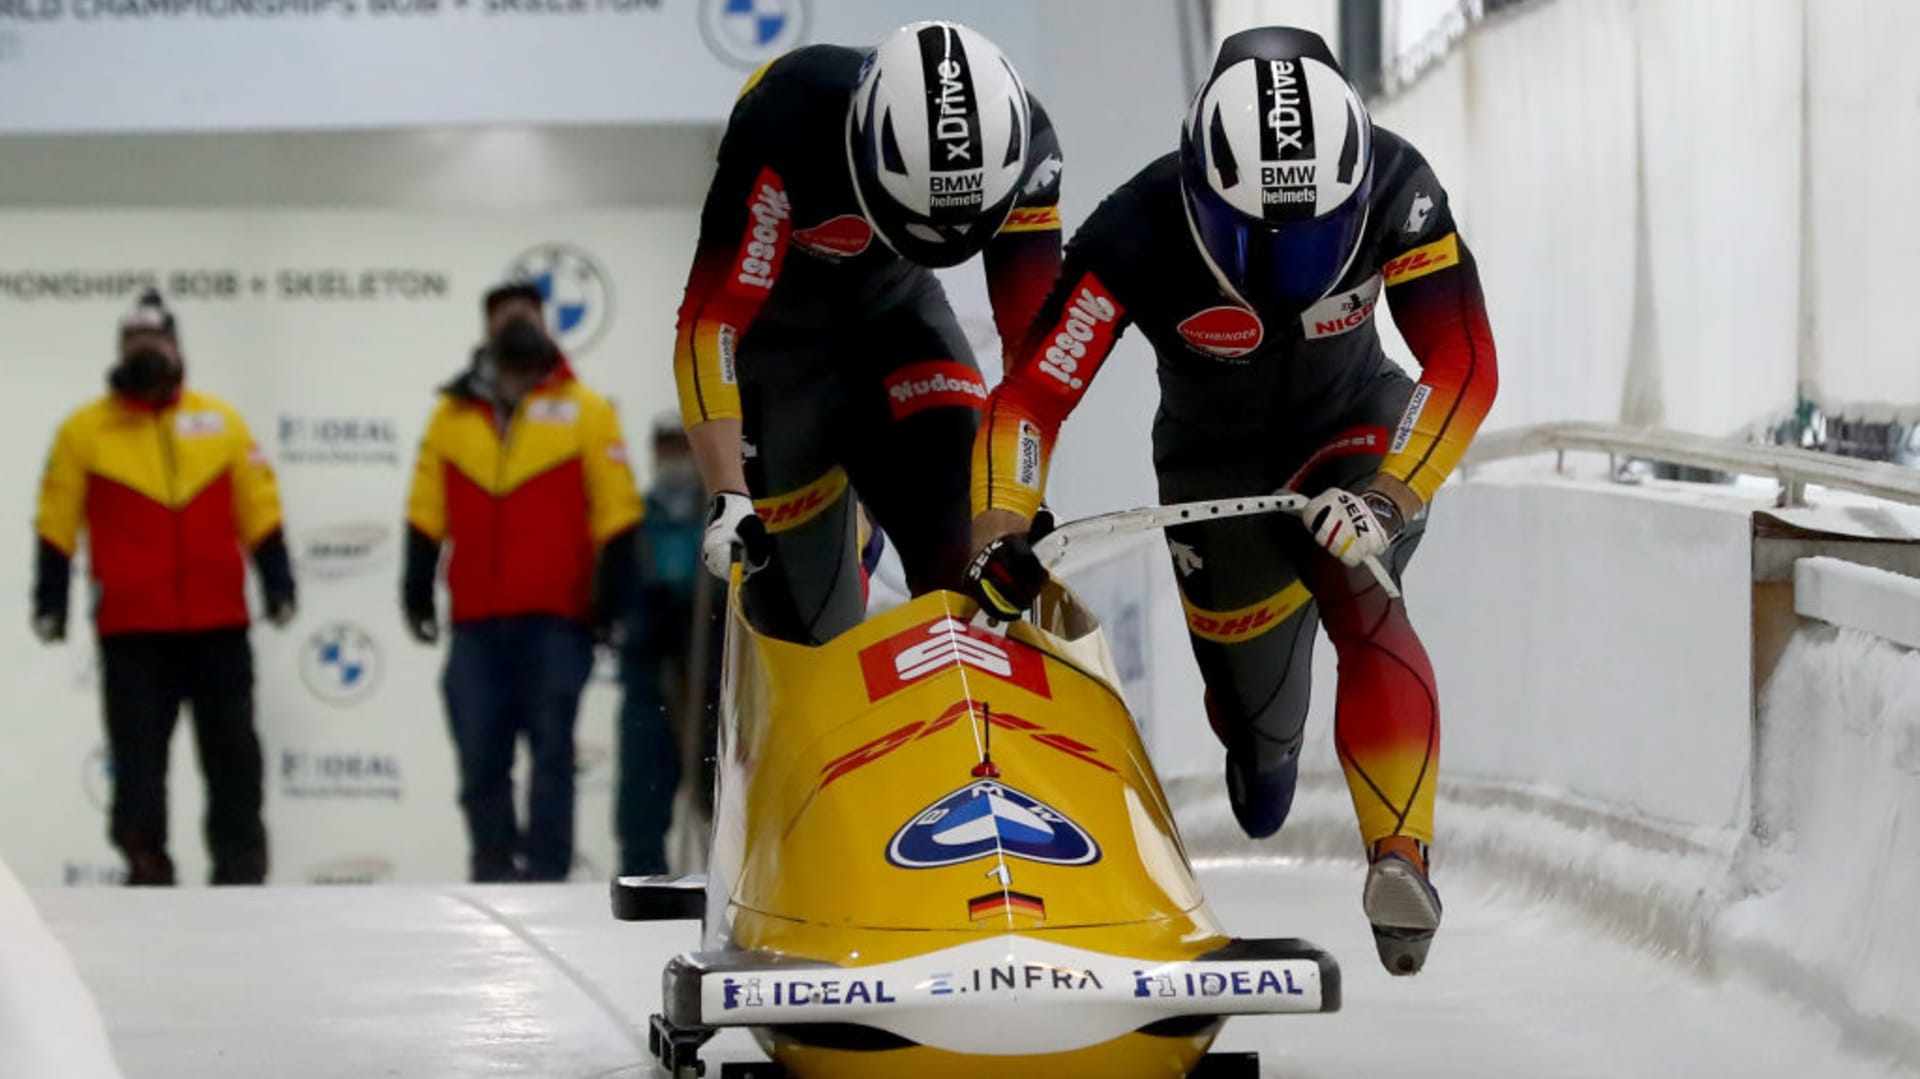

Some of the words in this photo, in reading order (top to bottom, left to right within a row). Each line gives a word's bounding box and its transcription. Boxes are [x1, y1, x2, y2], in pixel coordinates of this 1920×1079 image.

[935, 60, 971, 161] xDrive
[1266, 60, 1303, 150] xDrive
[930, 173, 983, 192] BMW
[1261, 166, 1316, 185] BMW
[930, 192, 983, 208] helmets
[1263, 188, 1316, 204] helmets
[276, 271, 450, 297] SKELETON
[1191, 606, 1275, 635] DHL
[916, 785, 1064, 826] BMW
[986, 864, 1013, 887] 1
[774, 980, 896, 1006] IDEAL
[1185, 969, 1304, 997] IDEAL
